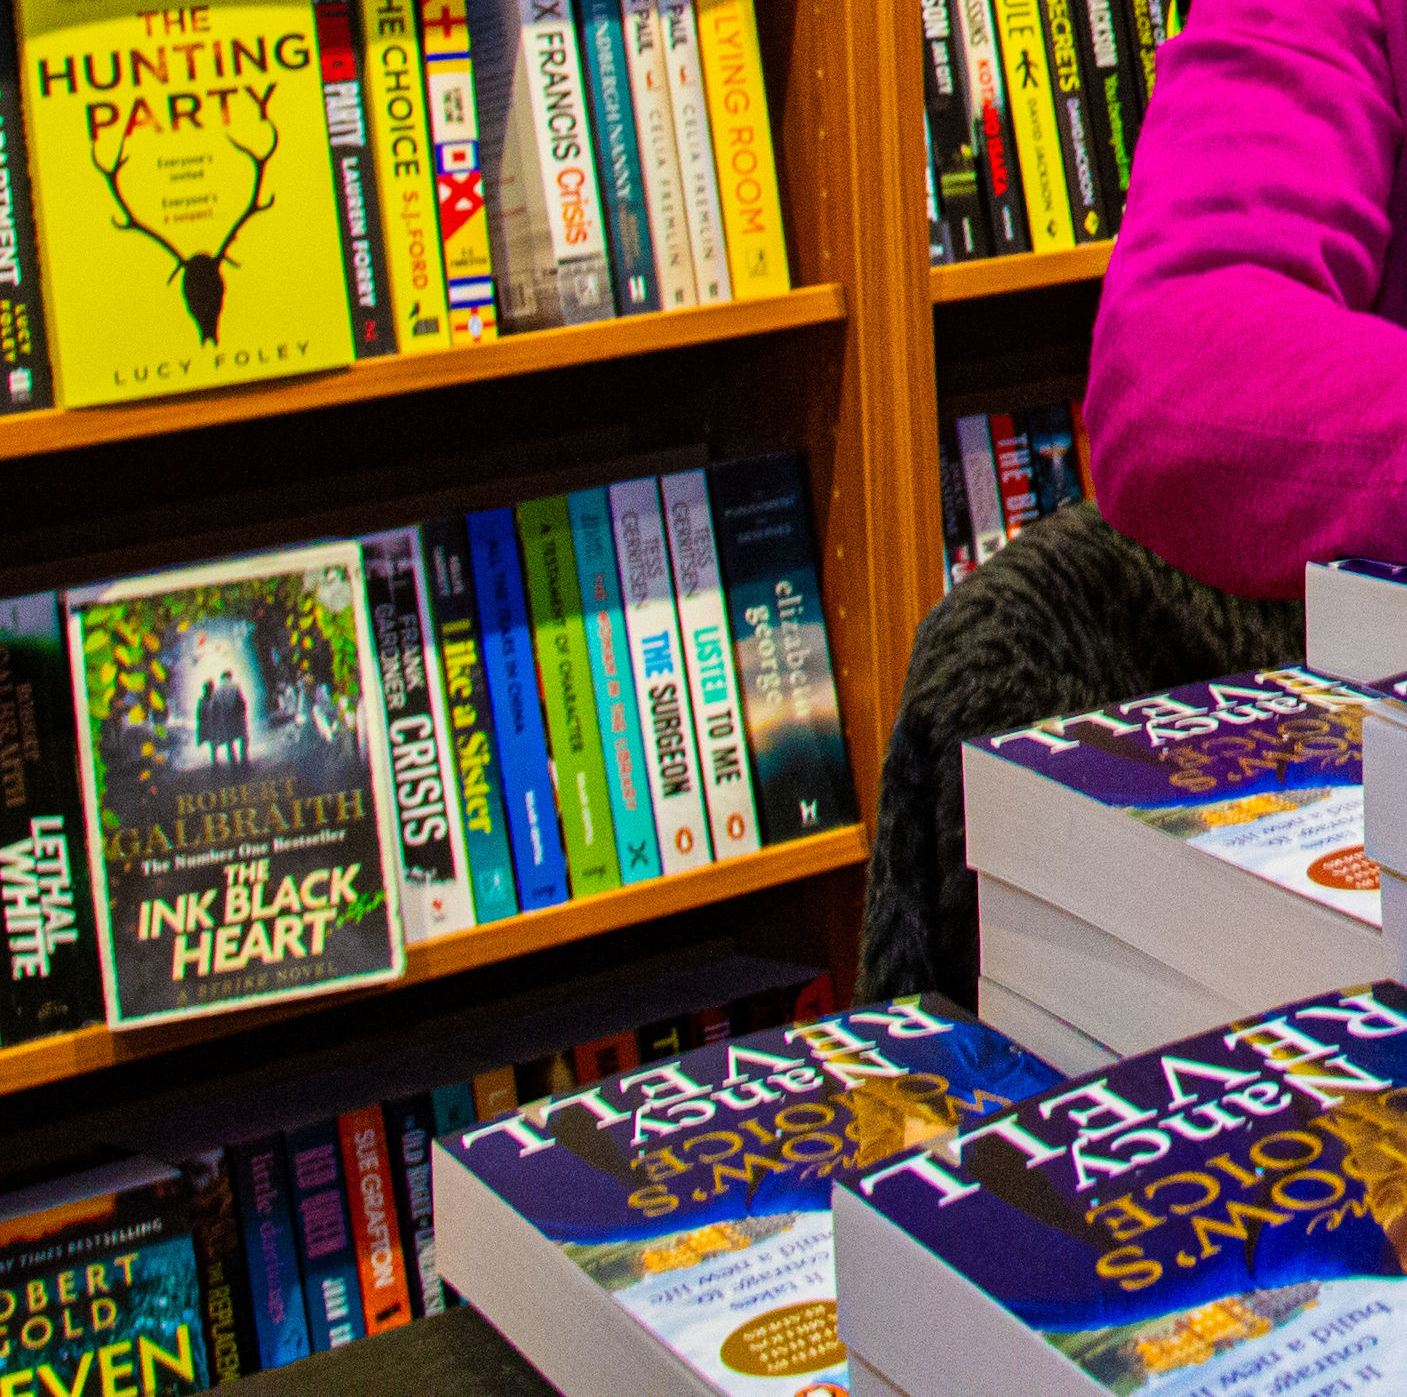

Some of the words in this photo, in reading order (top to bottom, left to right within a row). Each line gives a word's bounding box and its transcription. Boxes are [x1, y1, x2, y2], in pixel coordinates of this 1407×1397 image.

[137, 4, 211, 38] THE
[631, 12, 654, 55] PAUL
[664, 5, 688, 51] PAUL
[37, 32, 311, 98] HUNTING
[537, 30, 580, 162] FRANCIS
[714, 13, 750, 116] LYING
[84, 81, 278, 141] PARTY
[382, 45, 418, 180] CHOICE
[341, 157, 366, 240] LAUREN
[557, 167, 588, 248] Crisis
[730, 128, 765, 235] ROOM
[353, 240, 375, 307] FORRY
[113, 357, 192, 386] LUCY
[213, 341, 311, 370] FOLEY
[375, 605, 408, 712] GARDNER
[398, 614, 425, 693] FRANK
[641, 630, 673, 678] THE
[693, 626, 728, 704] LISTEN
[745, 605, 783, 705] george
[774, 580, 811, 718] elizabeth
[649, 682, 691, 799] SURGEON
[706, 709, 733, 741] TO
[177, 777, 295, 818] ROBERT
[390, 714, 447, 848] CRISIS
[458, 734, 493, 834] Sister
[711, 746, 741, 786] ME
[106, 789, 366, 860] GALBRAITH
[175, 848, 235, 869] Number
[273, 828, 346, 853] Bestseller
[0, 838, 48, 980] WHITE
[30, 815, 77, 954] LETHAL
[138, 888, 218, 942] INK
[224, 863, 361, 926] BLACK
[224, 859, 270, 887] THE
[173, 909, 337, 982] HEART
[354, 1128, 378, 1171] SUE
[359, 1172, 395, 1290] GRAFTON
